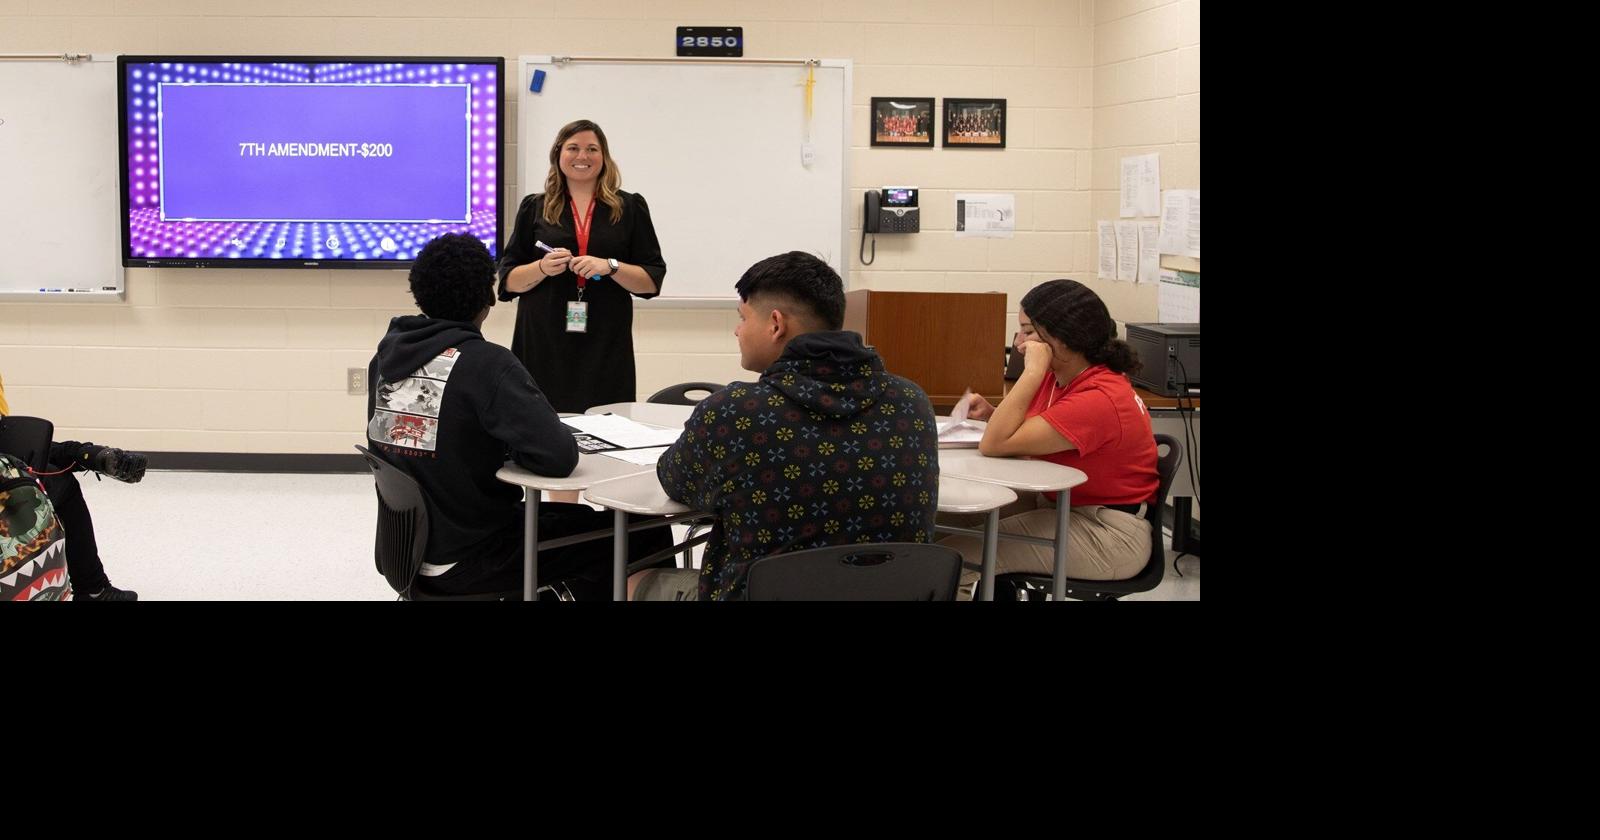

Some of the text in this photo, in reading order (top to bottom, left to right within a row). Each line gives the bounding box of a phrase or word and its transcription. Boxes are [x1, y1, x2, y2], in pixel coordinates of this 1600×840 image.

[682, 36, 737, 47] 2850
[239, 142, 393, 158] 7TH AMENDMENT-$200
